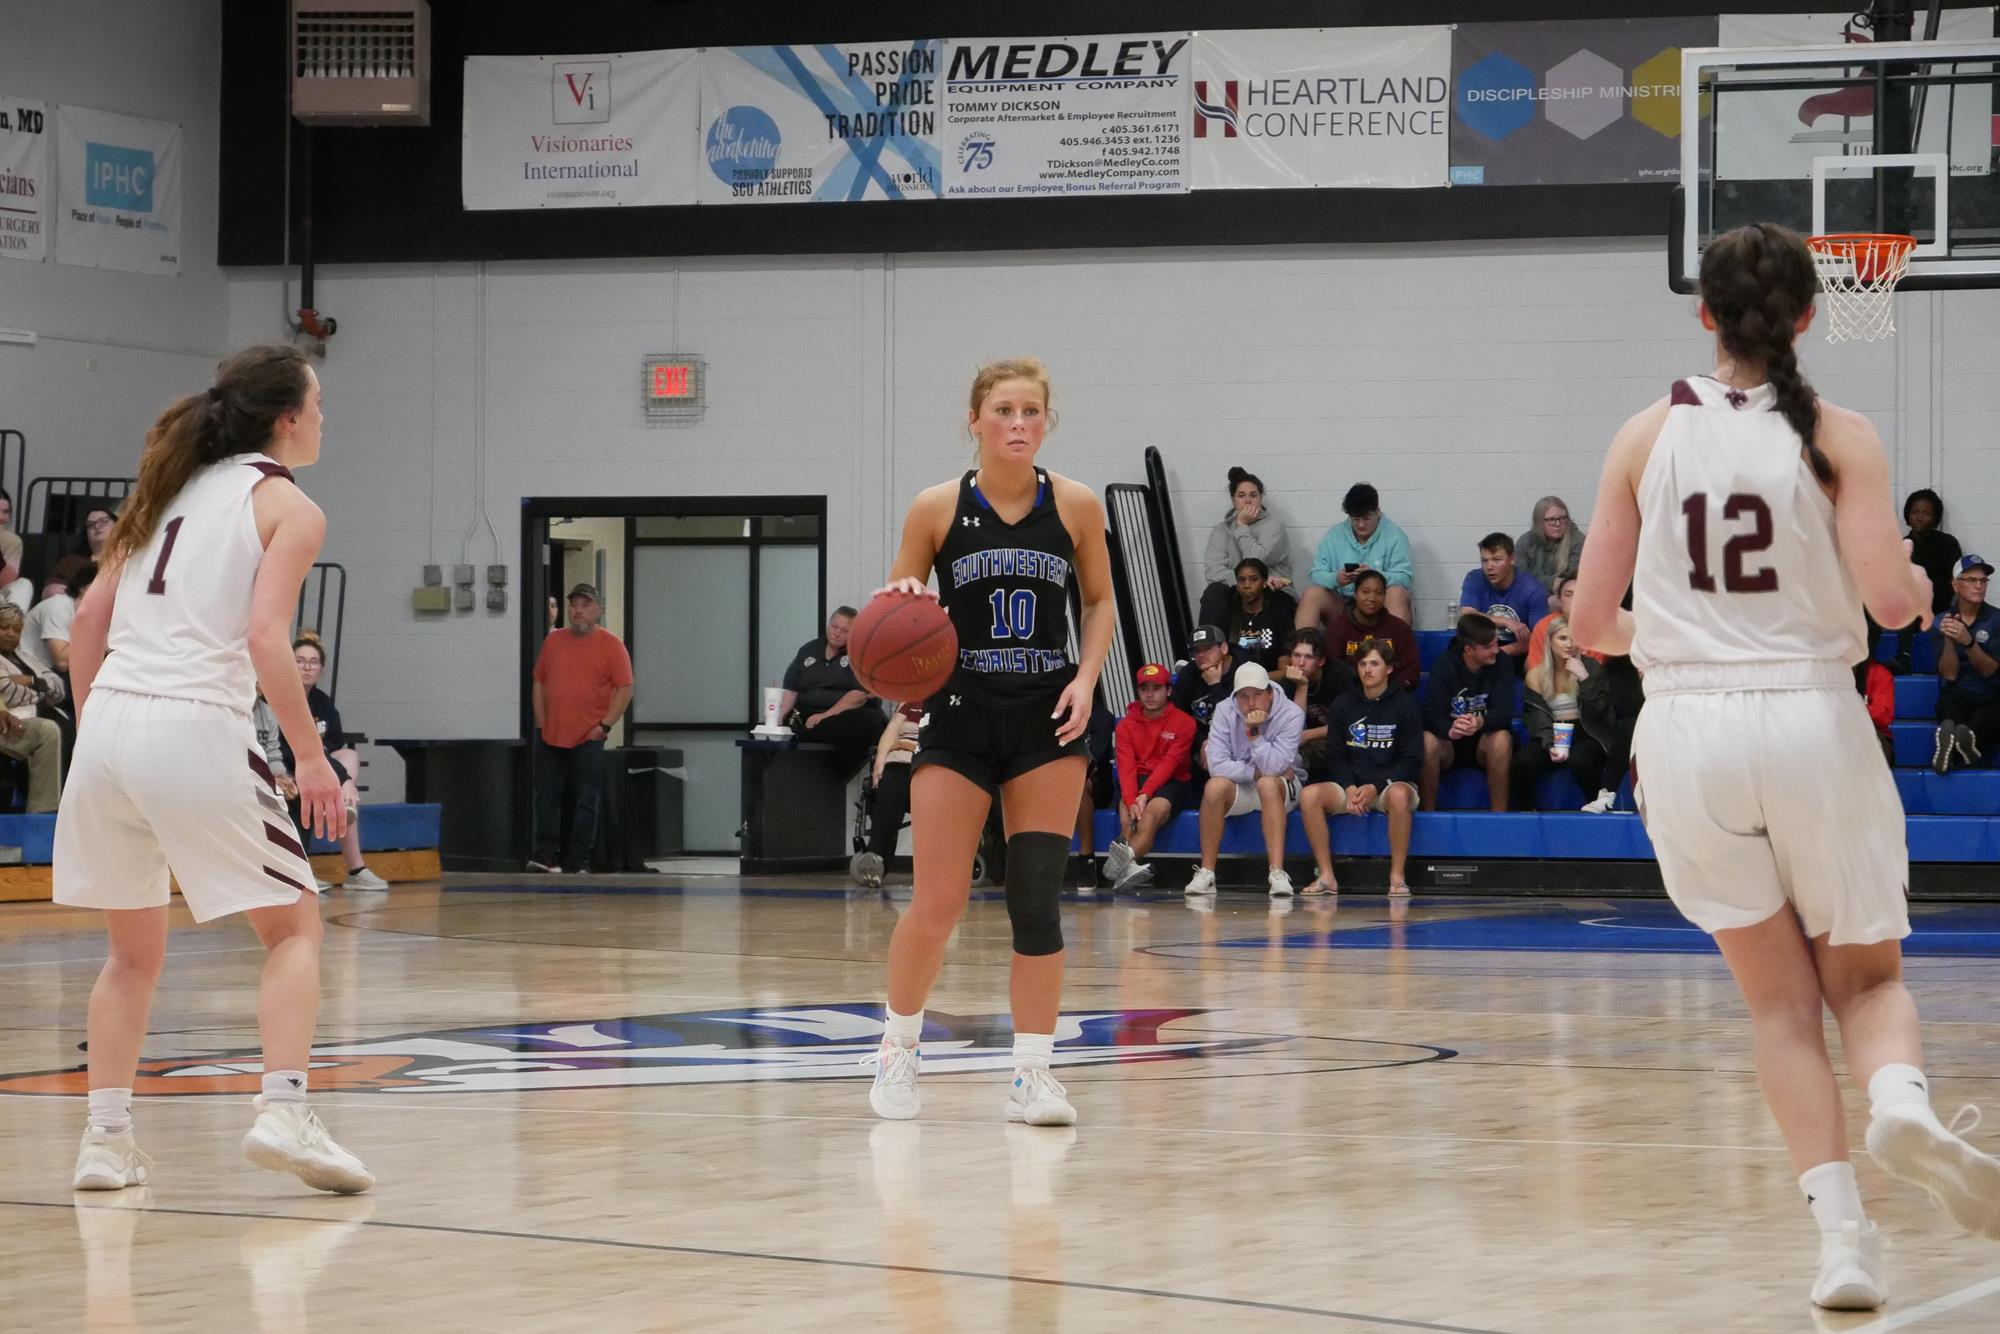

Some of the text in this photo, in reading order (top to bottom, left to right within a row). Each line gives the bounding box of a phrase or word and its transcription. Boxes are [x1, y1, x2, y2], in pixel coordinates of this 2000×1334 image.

[848, 49, 935, 77] PASSION
[947, 39, 1189, 80] MEDLEY
[875, 80, 934, 106] PRIDE
[947, 79, 1179, 94] EQUIPMENT COMPANY
[1248, 77, 1447, 106] HEARTLAND
[1467, 84, 1706, 102] DISCIPLESHIP MINISTRI
[948, 100, 1060, 113] TOMMY DICKSON
[17, 108, 44, 134] MD
[825, 110, 934, 139] TRADITION
[947, 110, 1177, 124] Corporate Aftermarket & Employee Recruitment
[1246, 111, 1445, 137] CONFERENCE
[1109, 124, 1180, 134] 405.361.6171
[530, 134, 633, 153] Visionaries
[1059, 135, 1180, 146] 405.946.3453 ext. 1236
[1108, 146, 1180, 155] 405.942.1748
[963, 141, 996, 172] 75
[1046, 157, 1180, 169] TDickson@MedleyCo.com
[93, 161, 146, 197] IPHC
[523, 159, 639, 180] International
[732, 167, 813, 180] PROUDLY SUPPORTS
[890, 166, 933, 184] world
[1039, 168, 1180, 180] www.MedleyCompany.com
[732, 180, 812, 197] SCU ATHLETICS
[948, 185, 966, 193] Ask
[968, 185, 996, 193] about
[1017, 184, 1064, 194] Employee
[1065, 183, 1096, 191] Bonus
[1098, 181, 1136, 190] Referral
[1138, 181, 1181, 191] Program
[655, 367, 688, 395] EXIT
[1682, 492, 1779, 593] 12
[146, 516, 185, 596] 1
[988, 588, 1037, 639] 10
